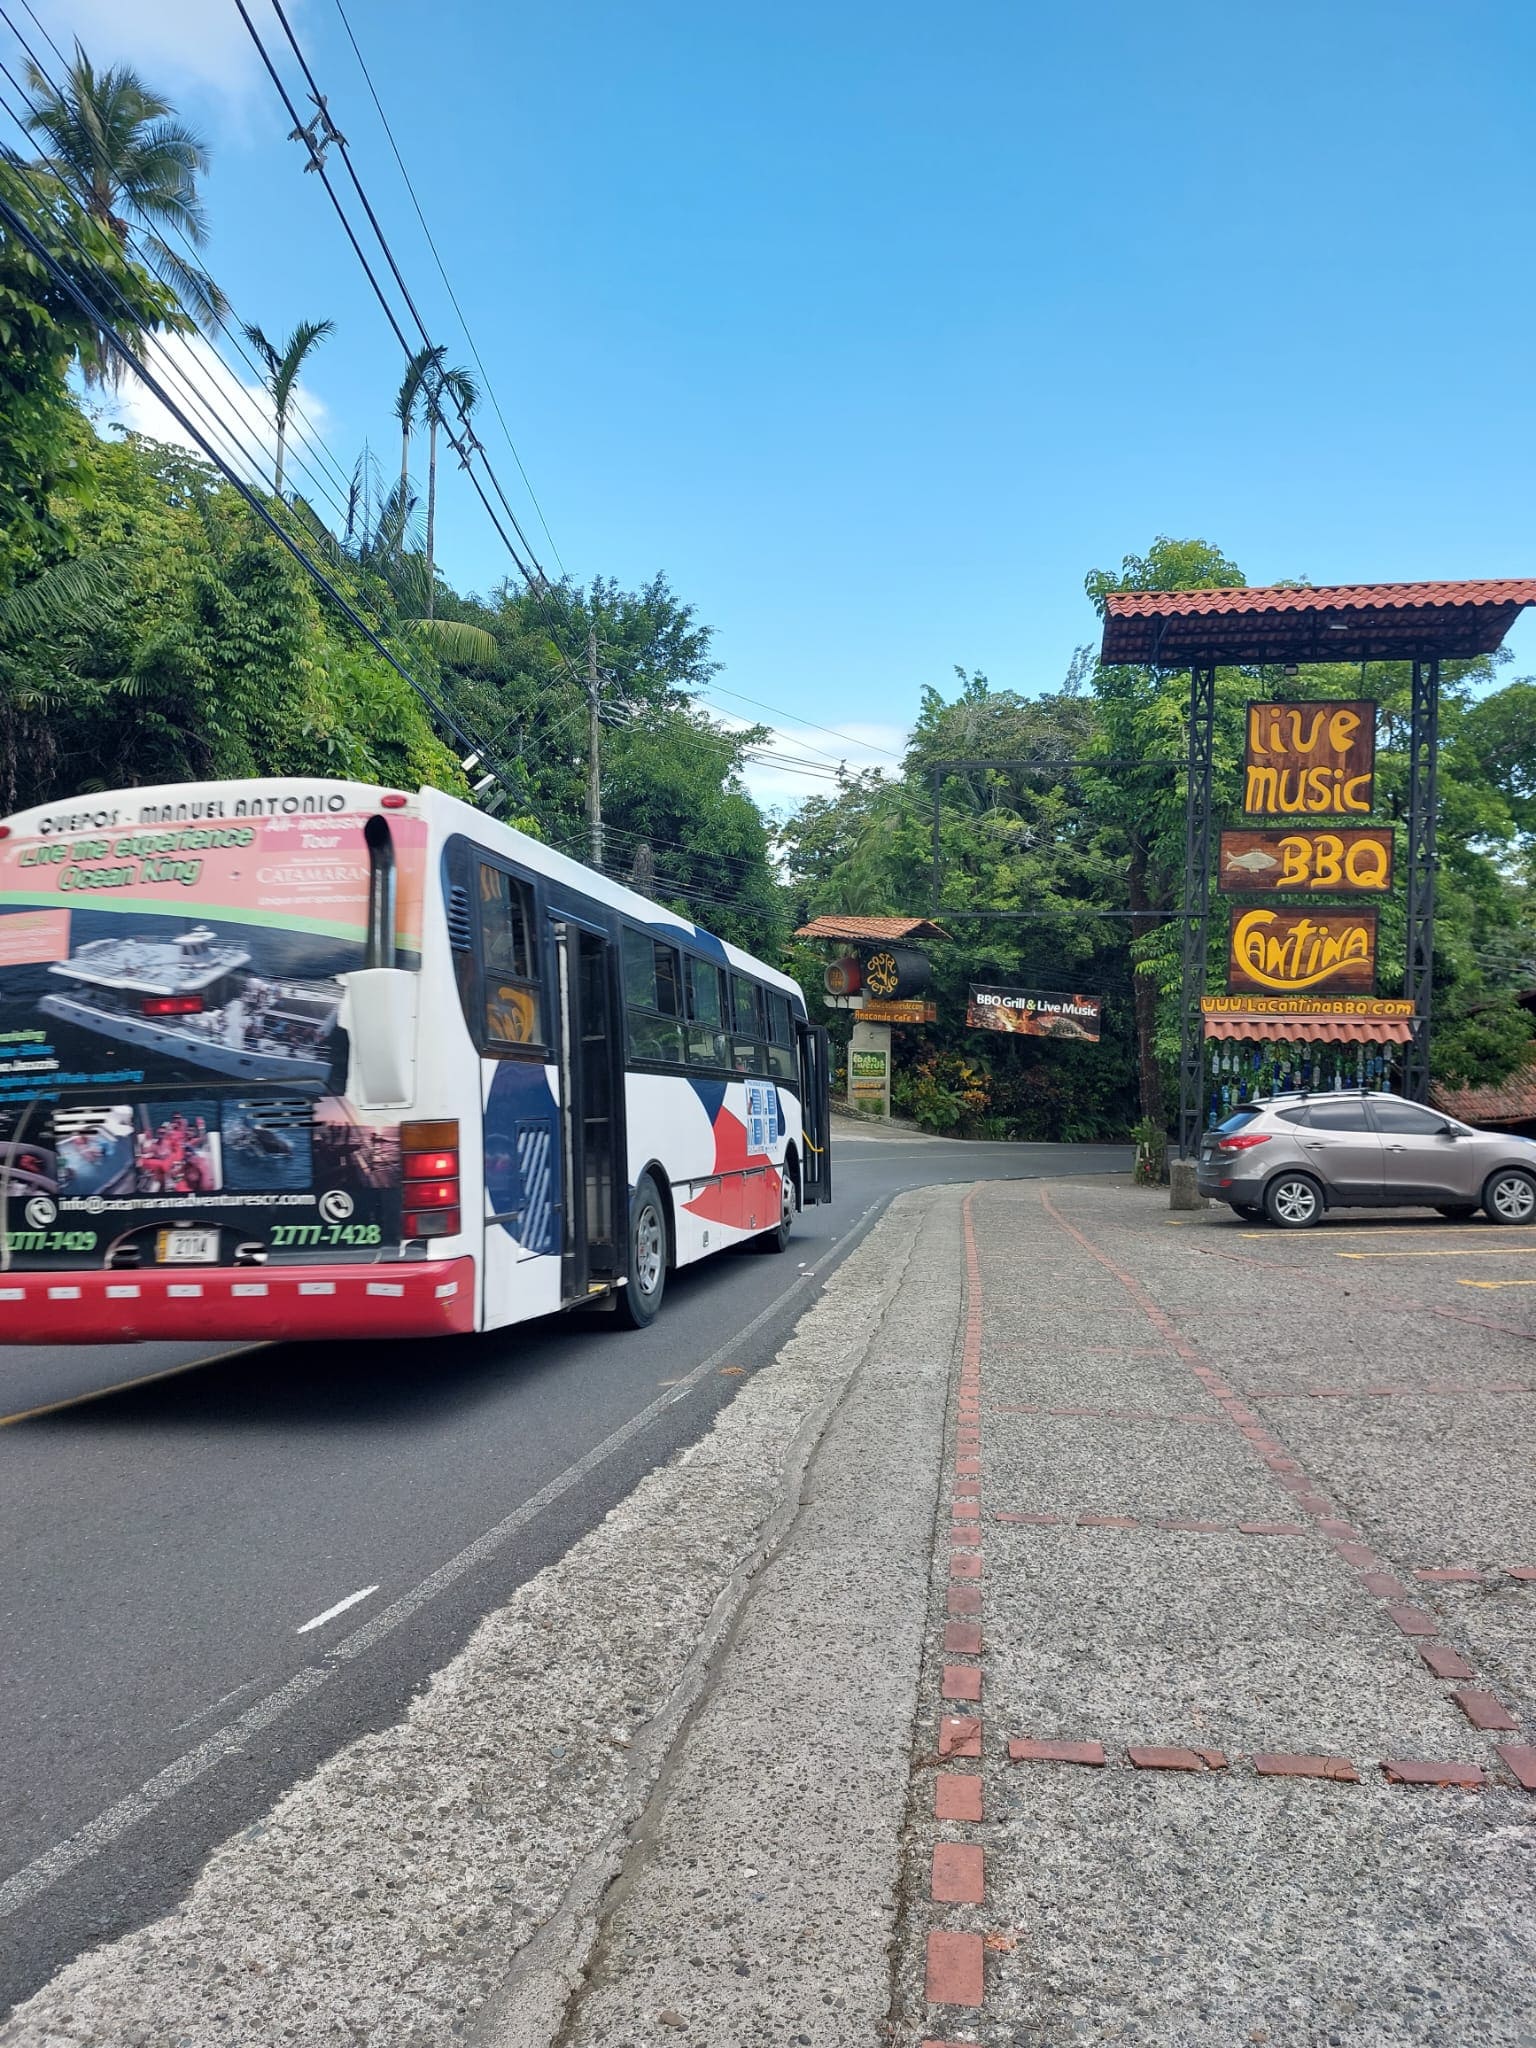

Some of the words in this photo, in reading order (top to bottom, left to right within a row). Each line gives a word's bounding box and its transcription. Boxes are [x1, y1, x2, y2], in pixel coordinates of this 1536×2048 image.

[39, 809, 119, 834] QUEPOS
[139, 801, 224, 823] MANUEL
[236, 795, 345, 816] ANTONIO
[113, 827, 256, 860] experience
[58, 865, 136, 890] Ocean
[140, 856, 204, 886] King
[1276, 835, 1388, 889] BBQ
[976, 994, 1001, 1006] BBQ
[1002, 996, 1025, 1010] Grill
[1026, 999, 1036, 1010] &
[1037, 1001, 1061, 1013] Live
[1062, 1003, 1097, 1017] Music
[271, 1225, 382, 1246] 2777-7428
